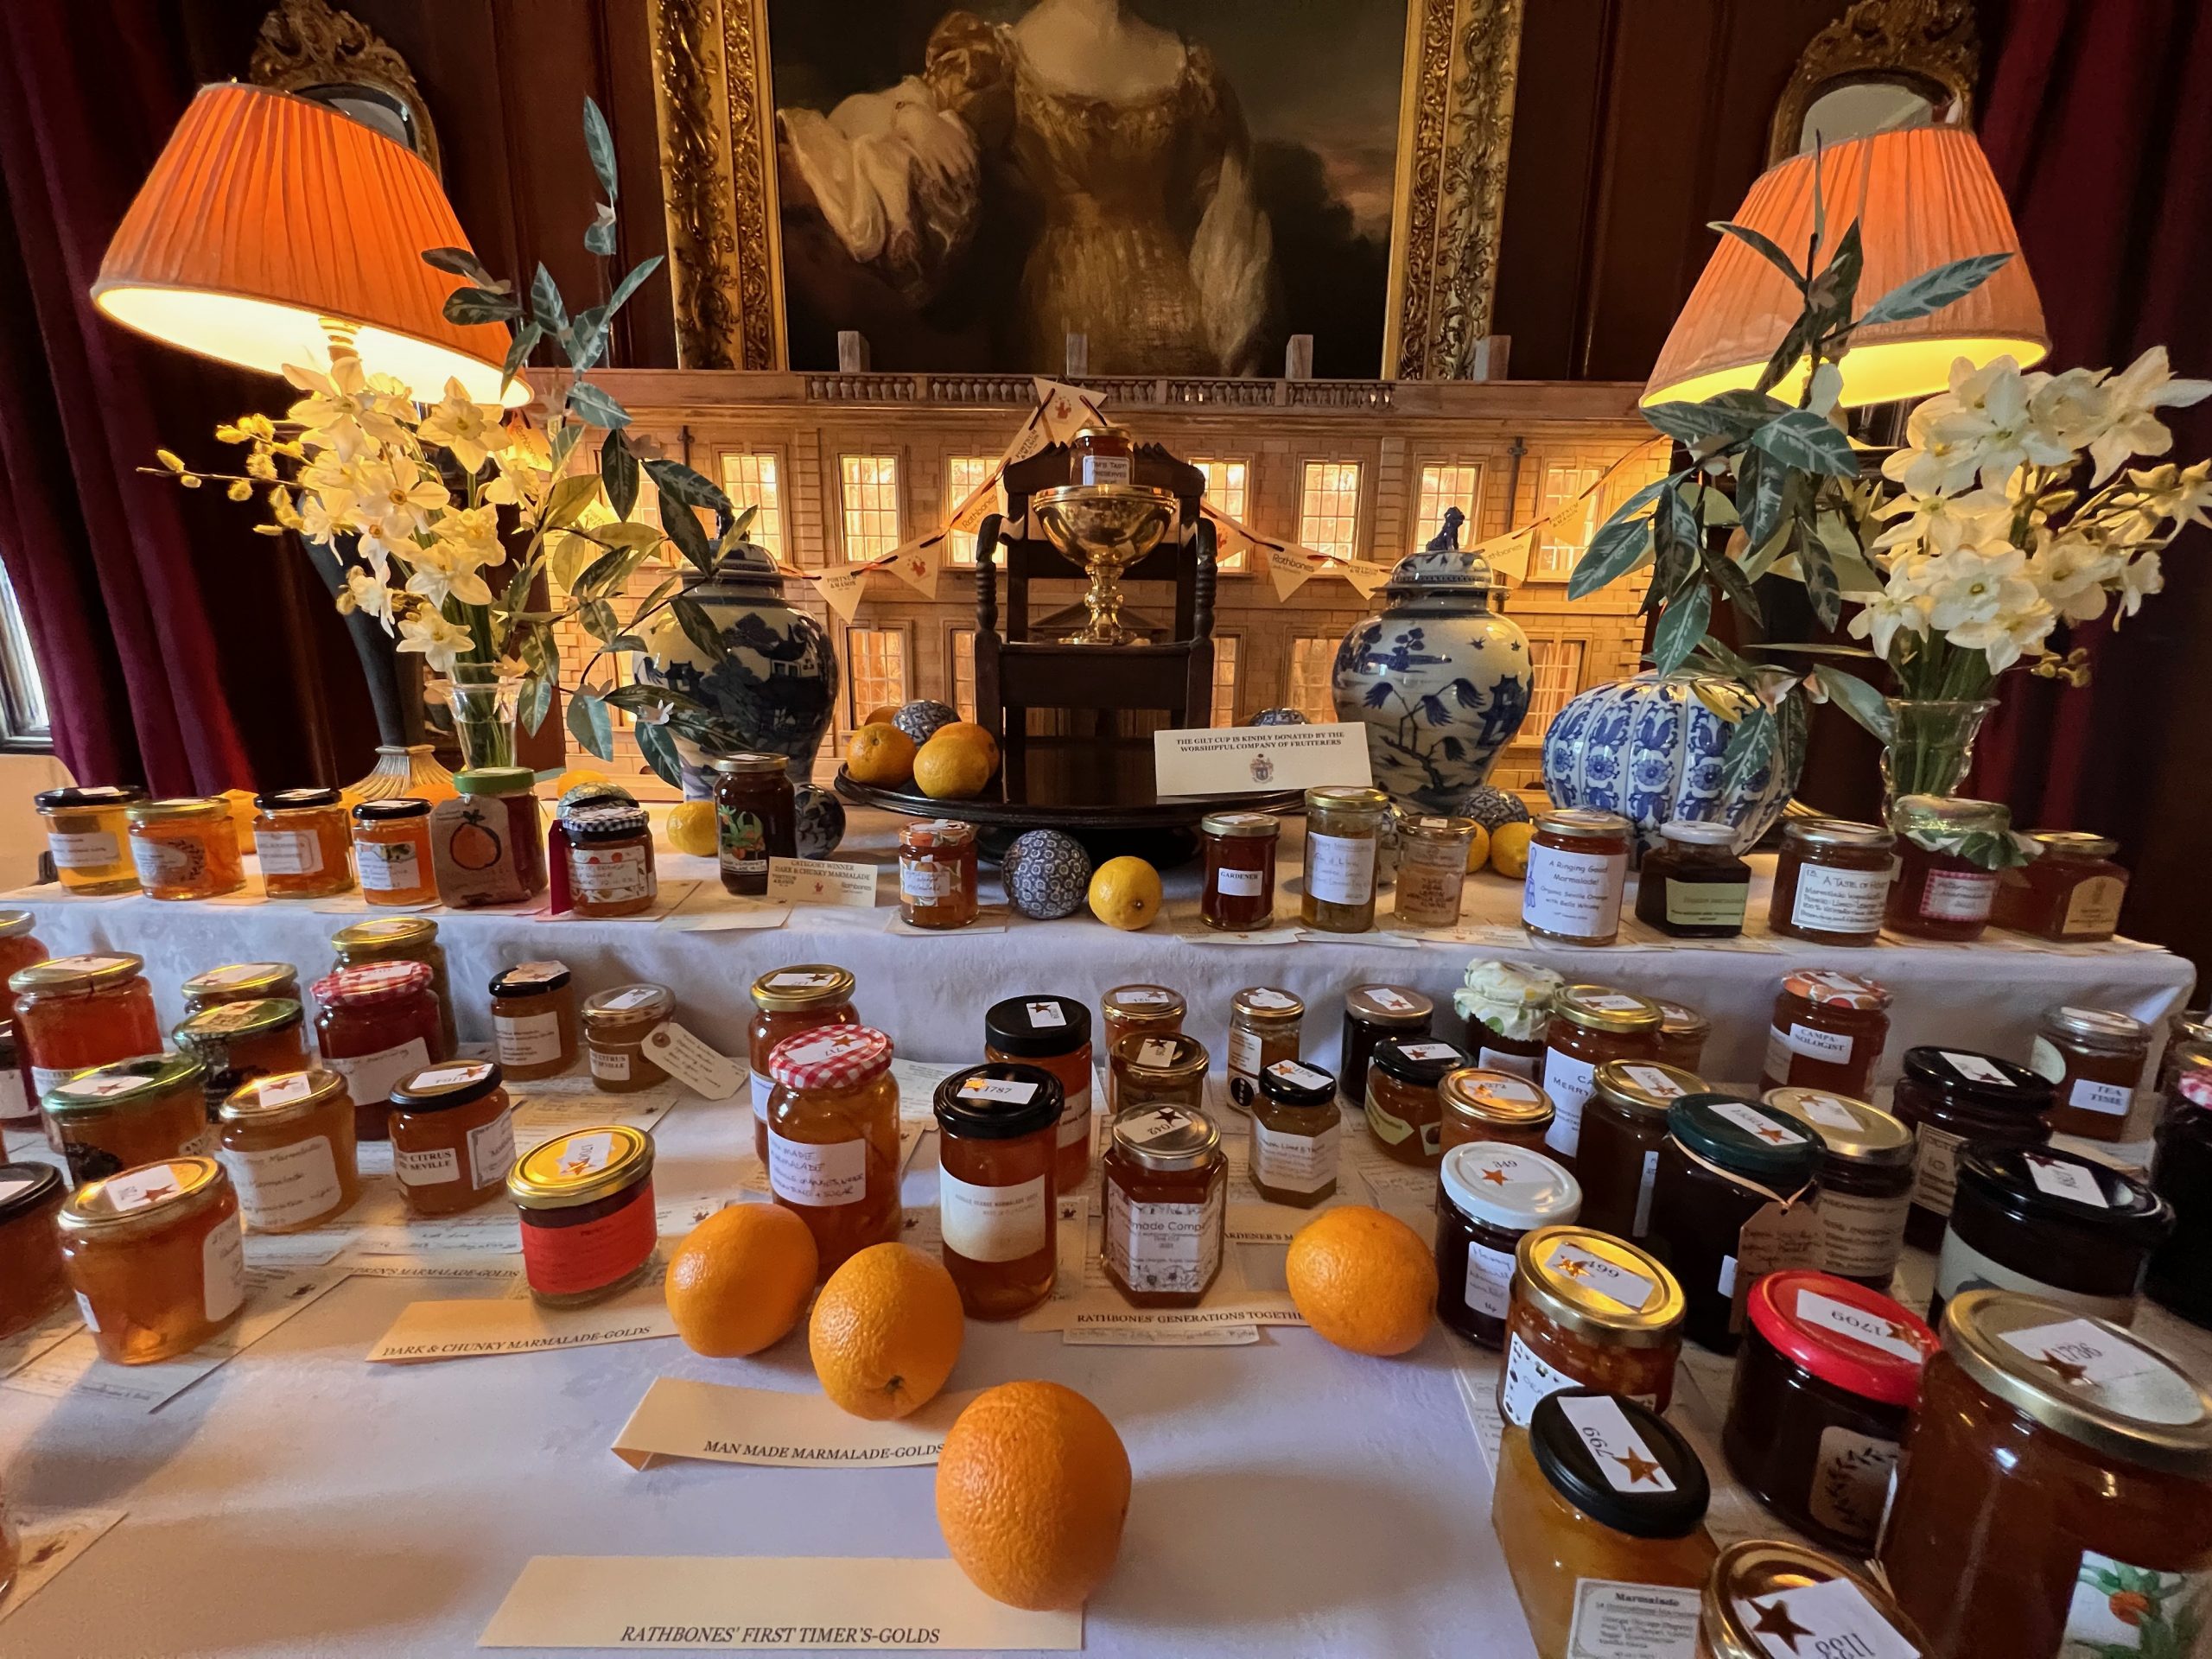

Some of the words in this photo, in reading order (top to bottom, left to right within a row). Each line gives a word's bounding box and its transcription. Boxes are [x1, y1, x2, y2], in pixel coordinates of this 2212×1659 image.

[962, 495, 998, 529] Rathbones
[1485, 544, 1524, 560] thbones
[1273, 554, 1314, 572] Rathbones
[827, 862, 855, 871] WINNER
[1556, 861, 1586, 874] Ringing
[828, 871, 870, 880] MARMALADE
[1220, 871, 1258, 880] GARDENER
[824, 1047, 844, 1057] 717
[2098, 1085, 2123, 1096] TEA
[1147, 1122, 1178, 1135] 1042
[410, 1151, 452, 1162] CITRUS
[410, 1160, 451, 1170] SEVILLE
[1224, 1232, 1282, 1241] ARDENER'S
[1077, 1313, 1155, 1325] RATHBONES'
[1157, 1312, 1246, 1324] GENERATIONS
[1247, 1311, 1306, 1321] TOGETHE
[1831, 1310, 1885, 1337] 1709
[382, 1344, 426, 1357] DARK
[427, 1344, 440, 1354] &
[441, 1340, 506, 1353] CHUNKY
[507, 1325, 652, 1351] MARMALADE-GOLDS
[703, 1440, 742, 1454] MAN
[743, 1445, 790, 1459] MADE
[791, 1443, 946, 1460] MARMALADE-GOLDS
[620, 1626, 740, 1643] RATHBONES'
[741, 1627, 798, 1643] FIRST
[799, 1627, 941, 1643] TIMER'S-GOLDS
